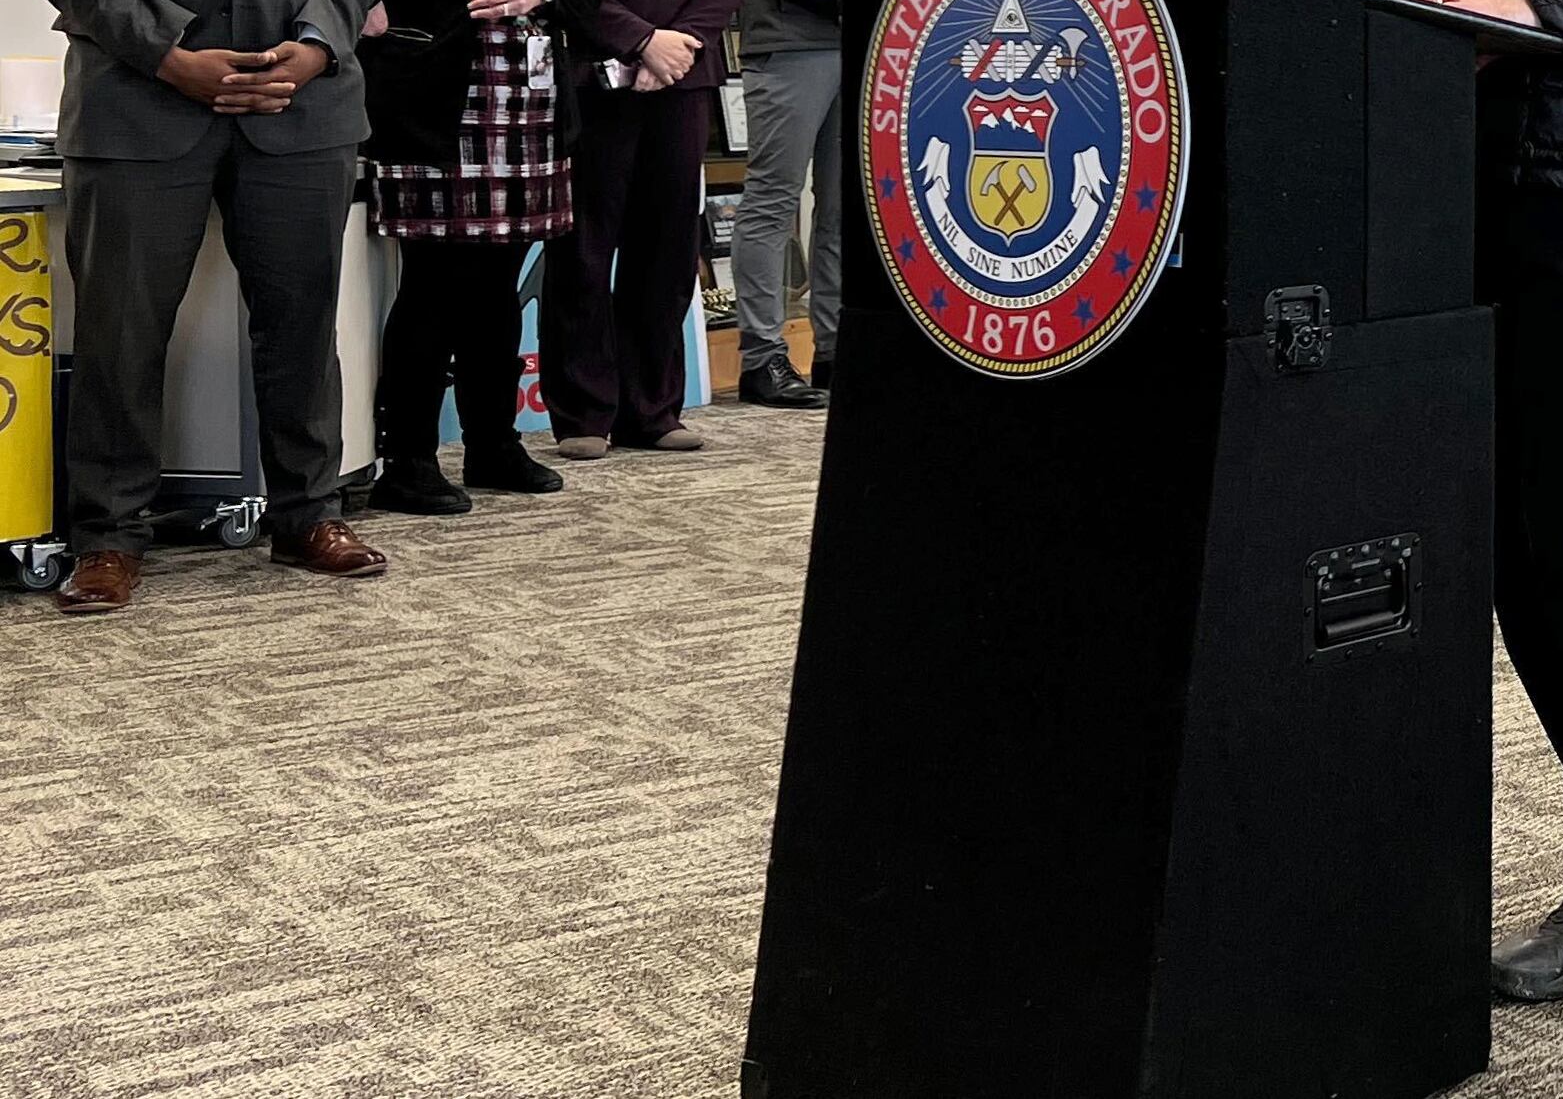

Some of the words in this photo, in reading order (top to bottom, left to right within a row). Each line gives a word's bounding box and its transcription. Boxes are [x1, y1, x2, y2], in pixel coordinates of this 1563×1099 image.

[936, 212, 960, 249] NIL
[966, 247, 1002, 278] SINE
[1010, 229, 1080, 280] NUMINE
[962, 304, 1057, 356] 1876
[525, 358, 536, 370] S
